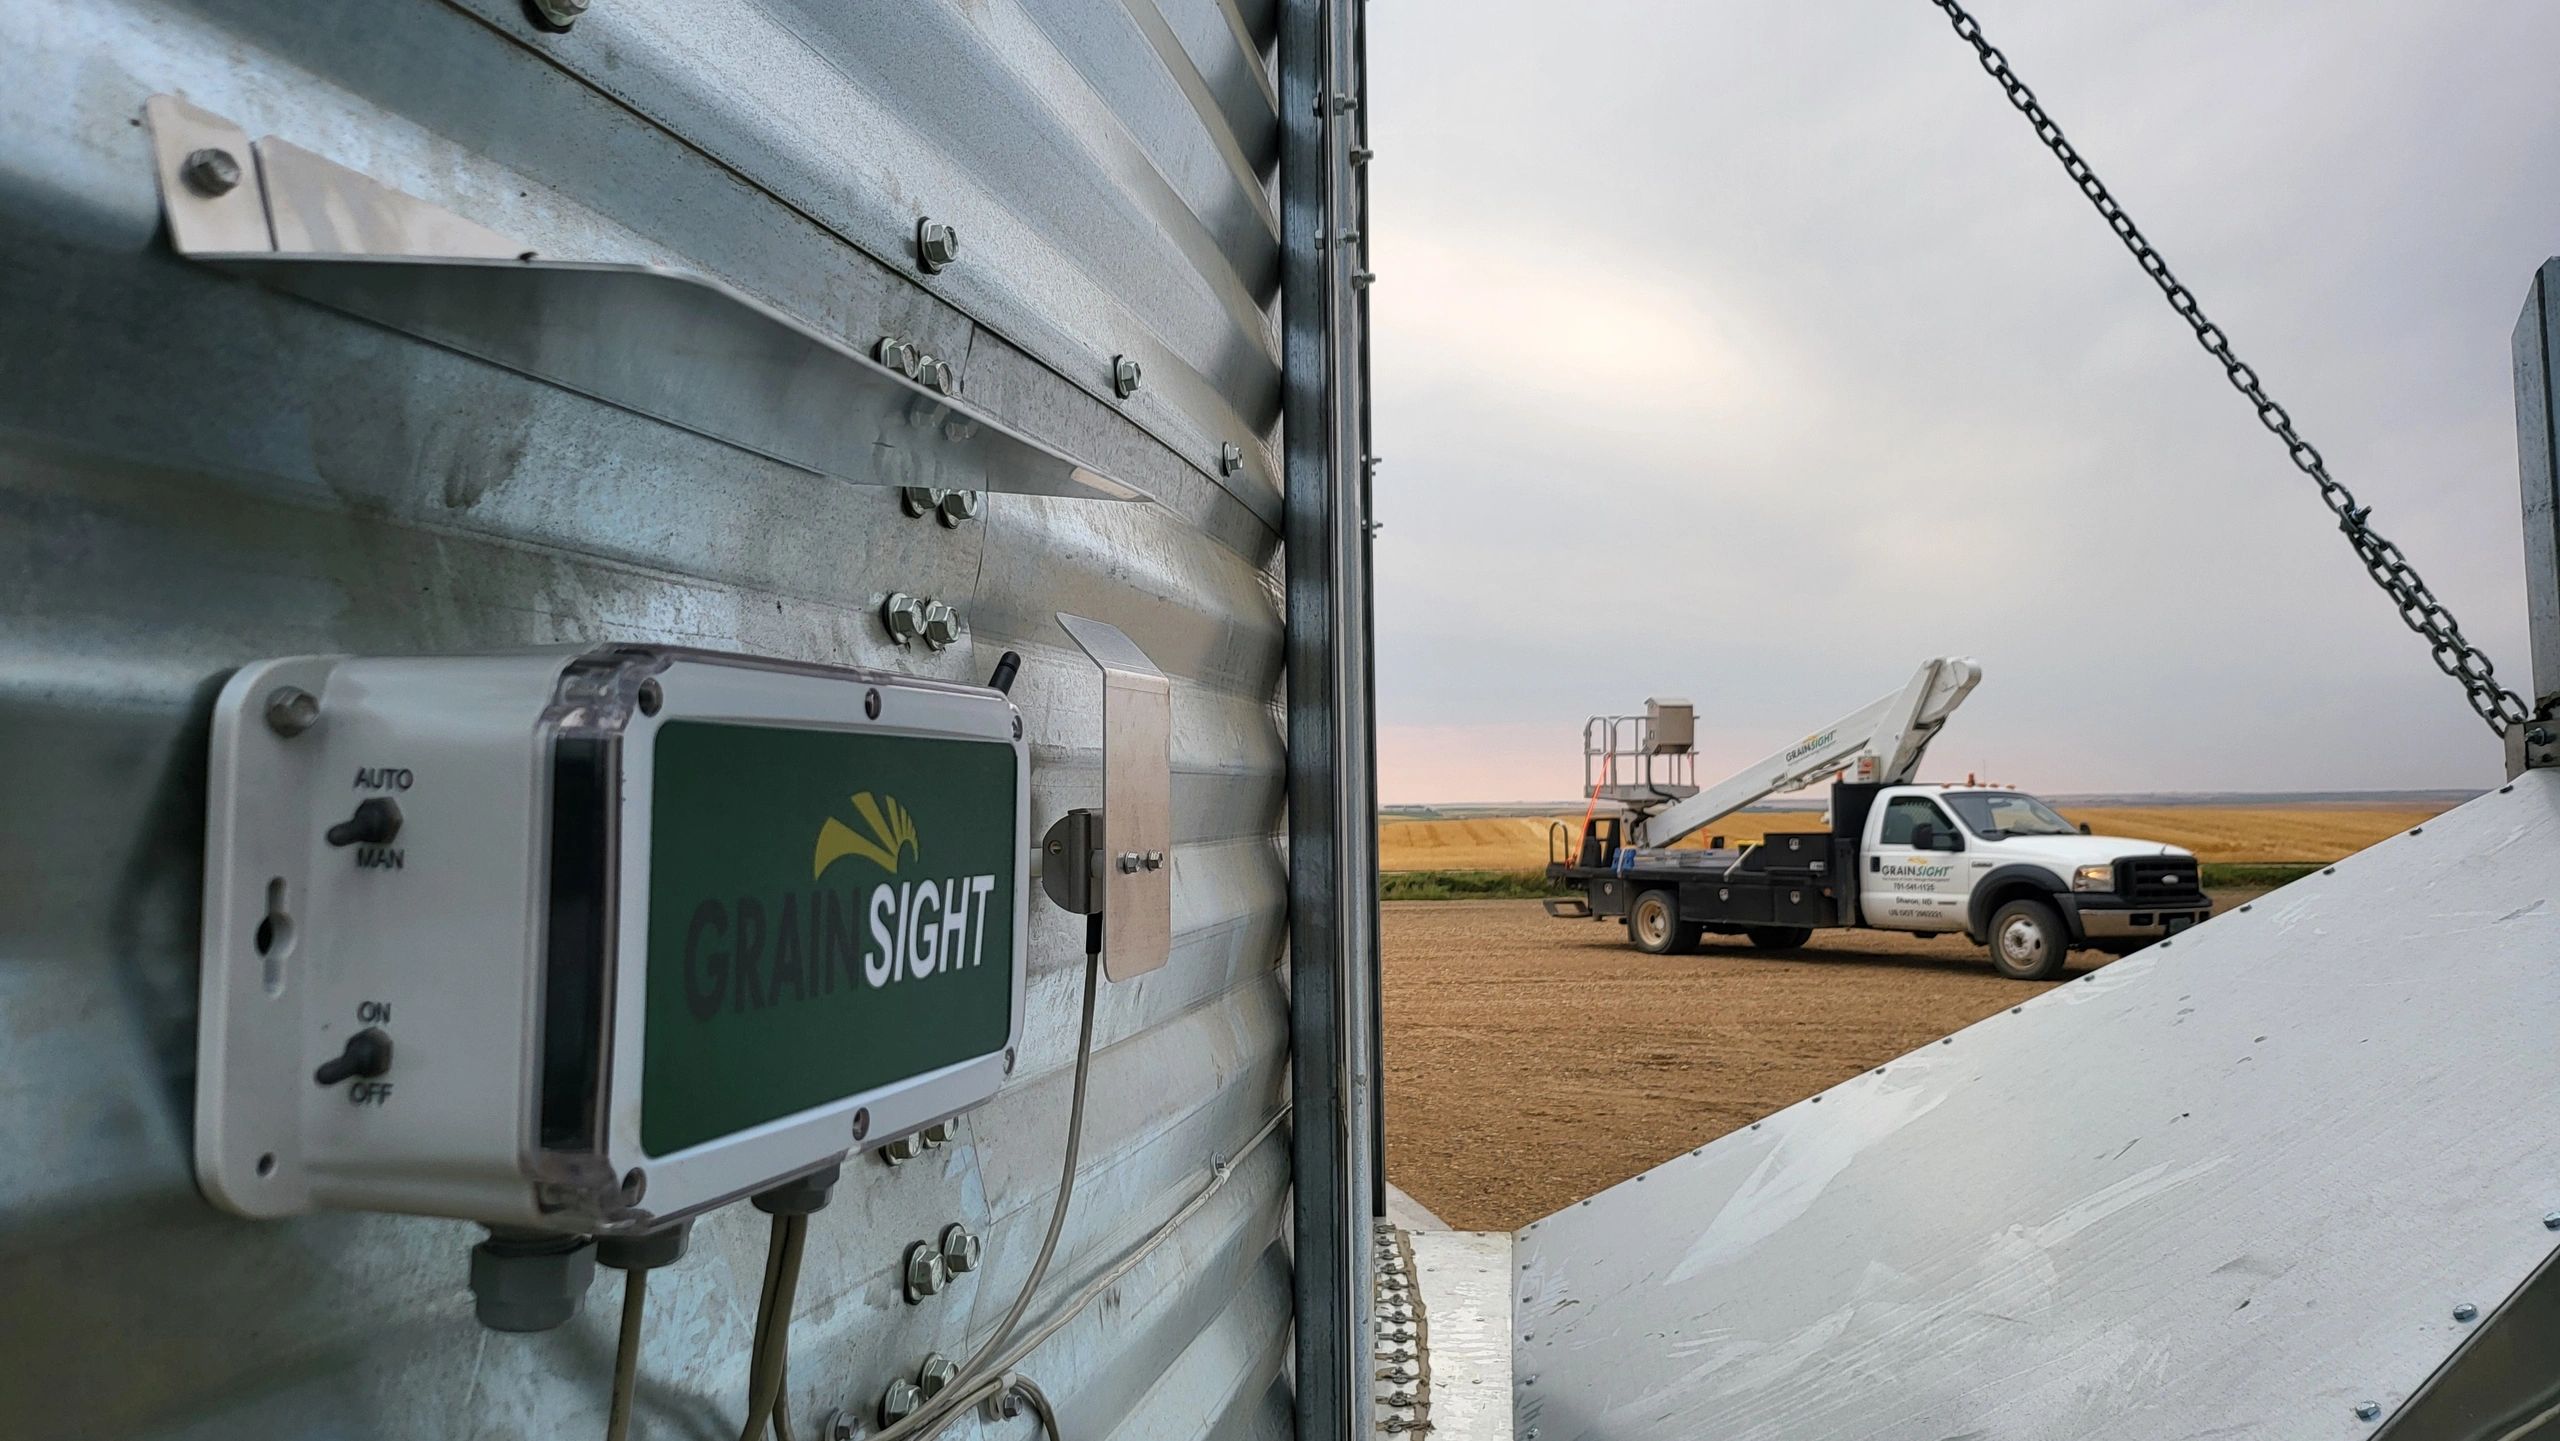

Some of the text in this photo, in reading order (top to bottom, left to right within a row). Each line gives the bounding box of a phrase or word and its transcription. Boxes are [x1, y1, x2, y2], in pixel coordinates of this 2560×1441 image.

[1785, 730, 1835, 762] GRAINSIGHT
[352, 767, 414, 792] AUTO
[357, 847, 405, 870] MAN
[1881, 865, 1950, 877] GRAINSIGHT
[683, 873, 996, 1023] GRAINSIGHT
[357, 1001, 391, 1024] ON
[349, 1082, 394, 1106] OFF
